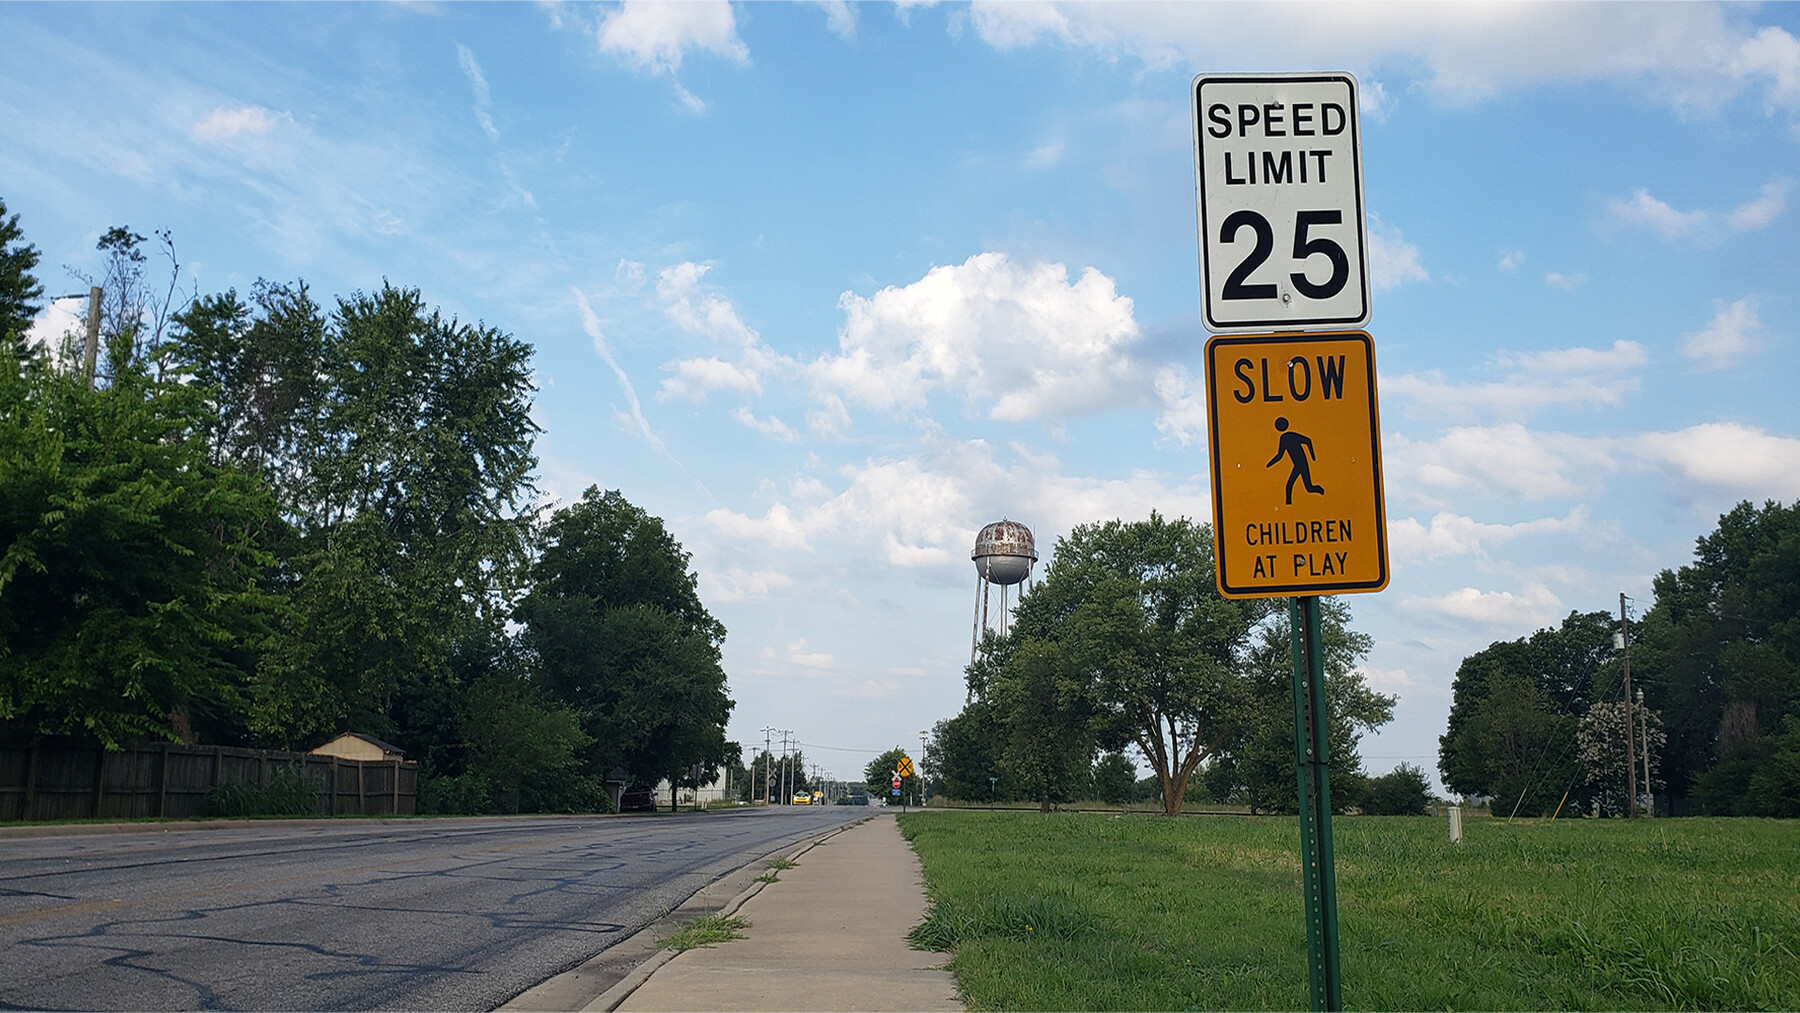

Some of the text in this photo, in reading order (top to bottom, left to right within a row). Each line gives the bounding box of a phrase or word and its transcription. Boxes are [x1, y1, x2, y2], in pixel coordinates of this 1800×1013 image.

[1207, 102, 1346, 139] SPEED
[1224, 149, 1333, 185] LIMIT
[1219, 209, 1350, 300] 25
[1233, 355, 1346, 404] SLOW
[1246, 519, 1353, 546] CHILDREN
[1252, 551, 1348, 579] AT PLAY
